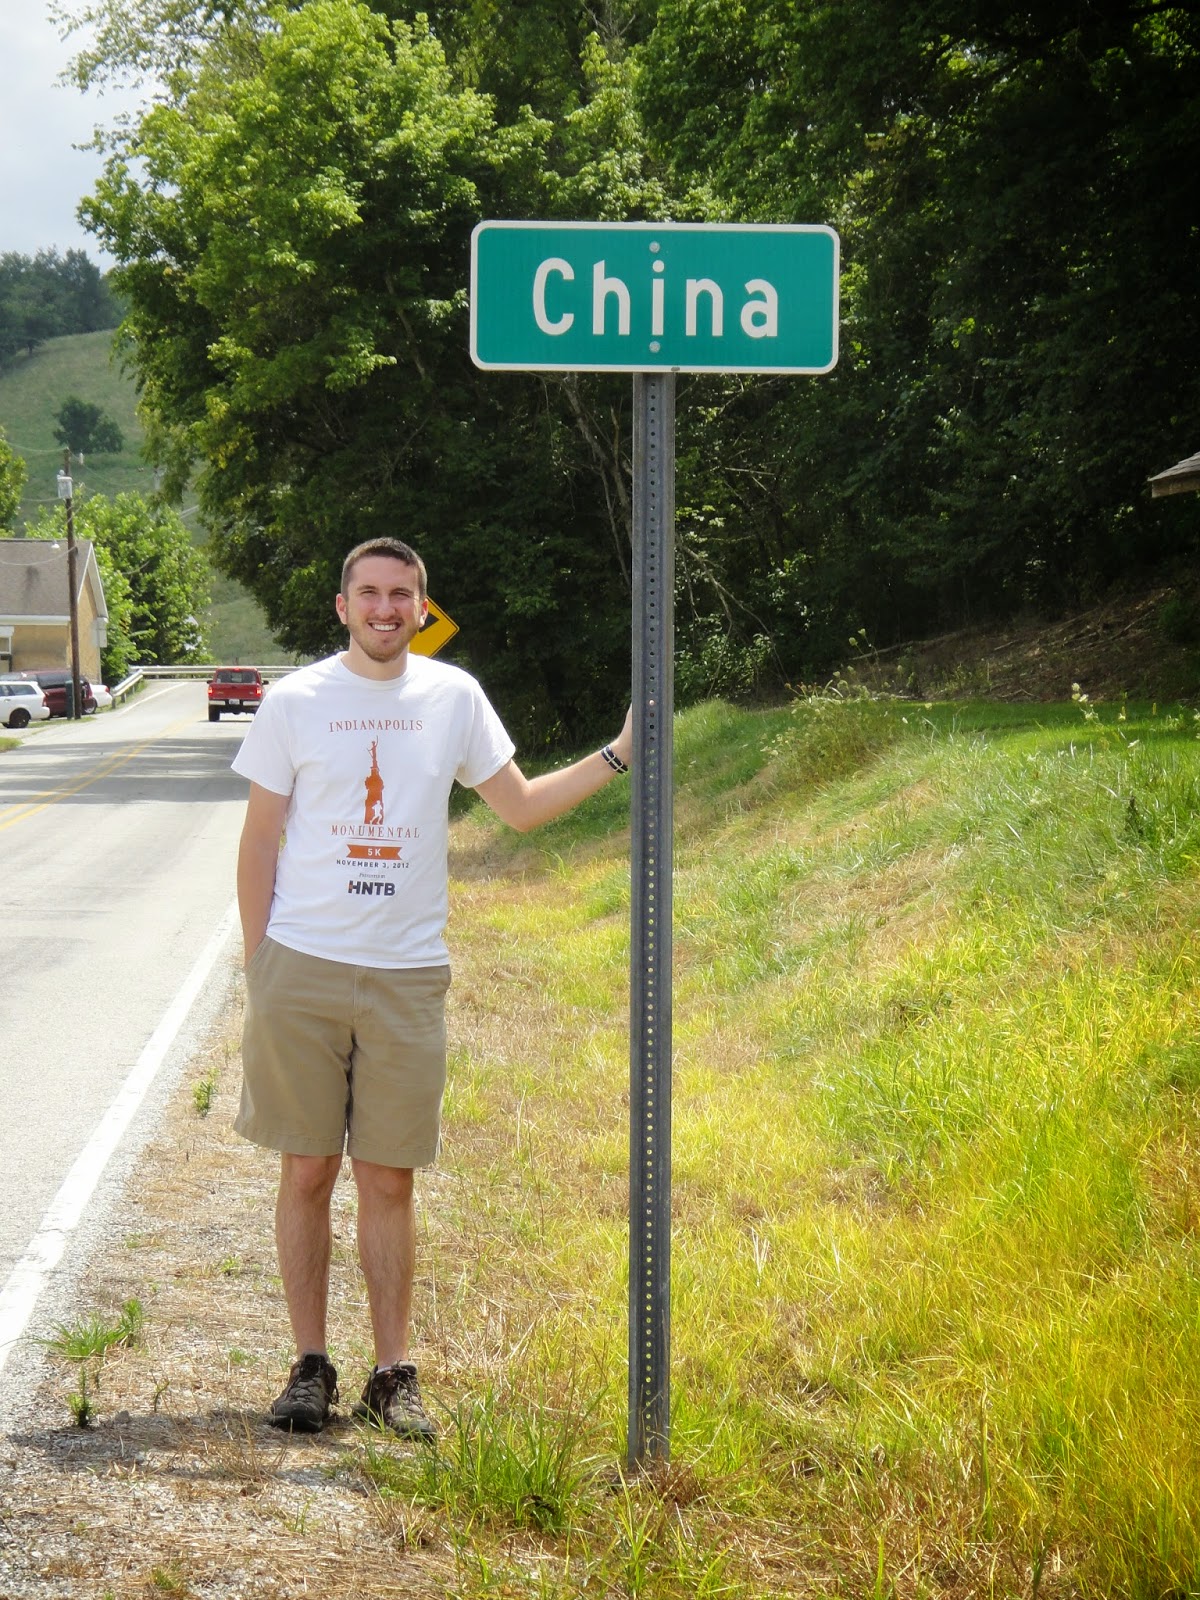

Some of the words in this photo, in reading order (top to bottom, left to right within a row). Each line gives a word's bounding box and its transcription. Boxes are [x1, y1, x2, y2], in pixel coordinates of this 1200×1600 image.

[532, 257, 778, 338] China
[329, 719, 423, 732] INDIANAPOLIS
[331, 825, 420, 838] MONUMENTAL
[336, 859, 379, 868] NOVEMBER
[347, 880, 396, 896] HNTB
